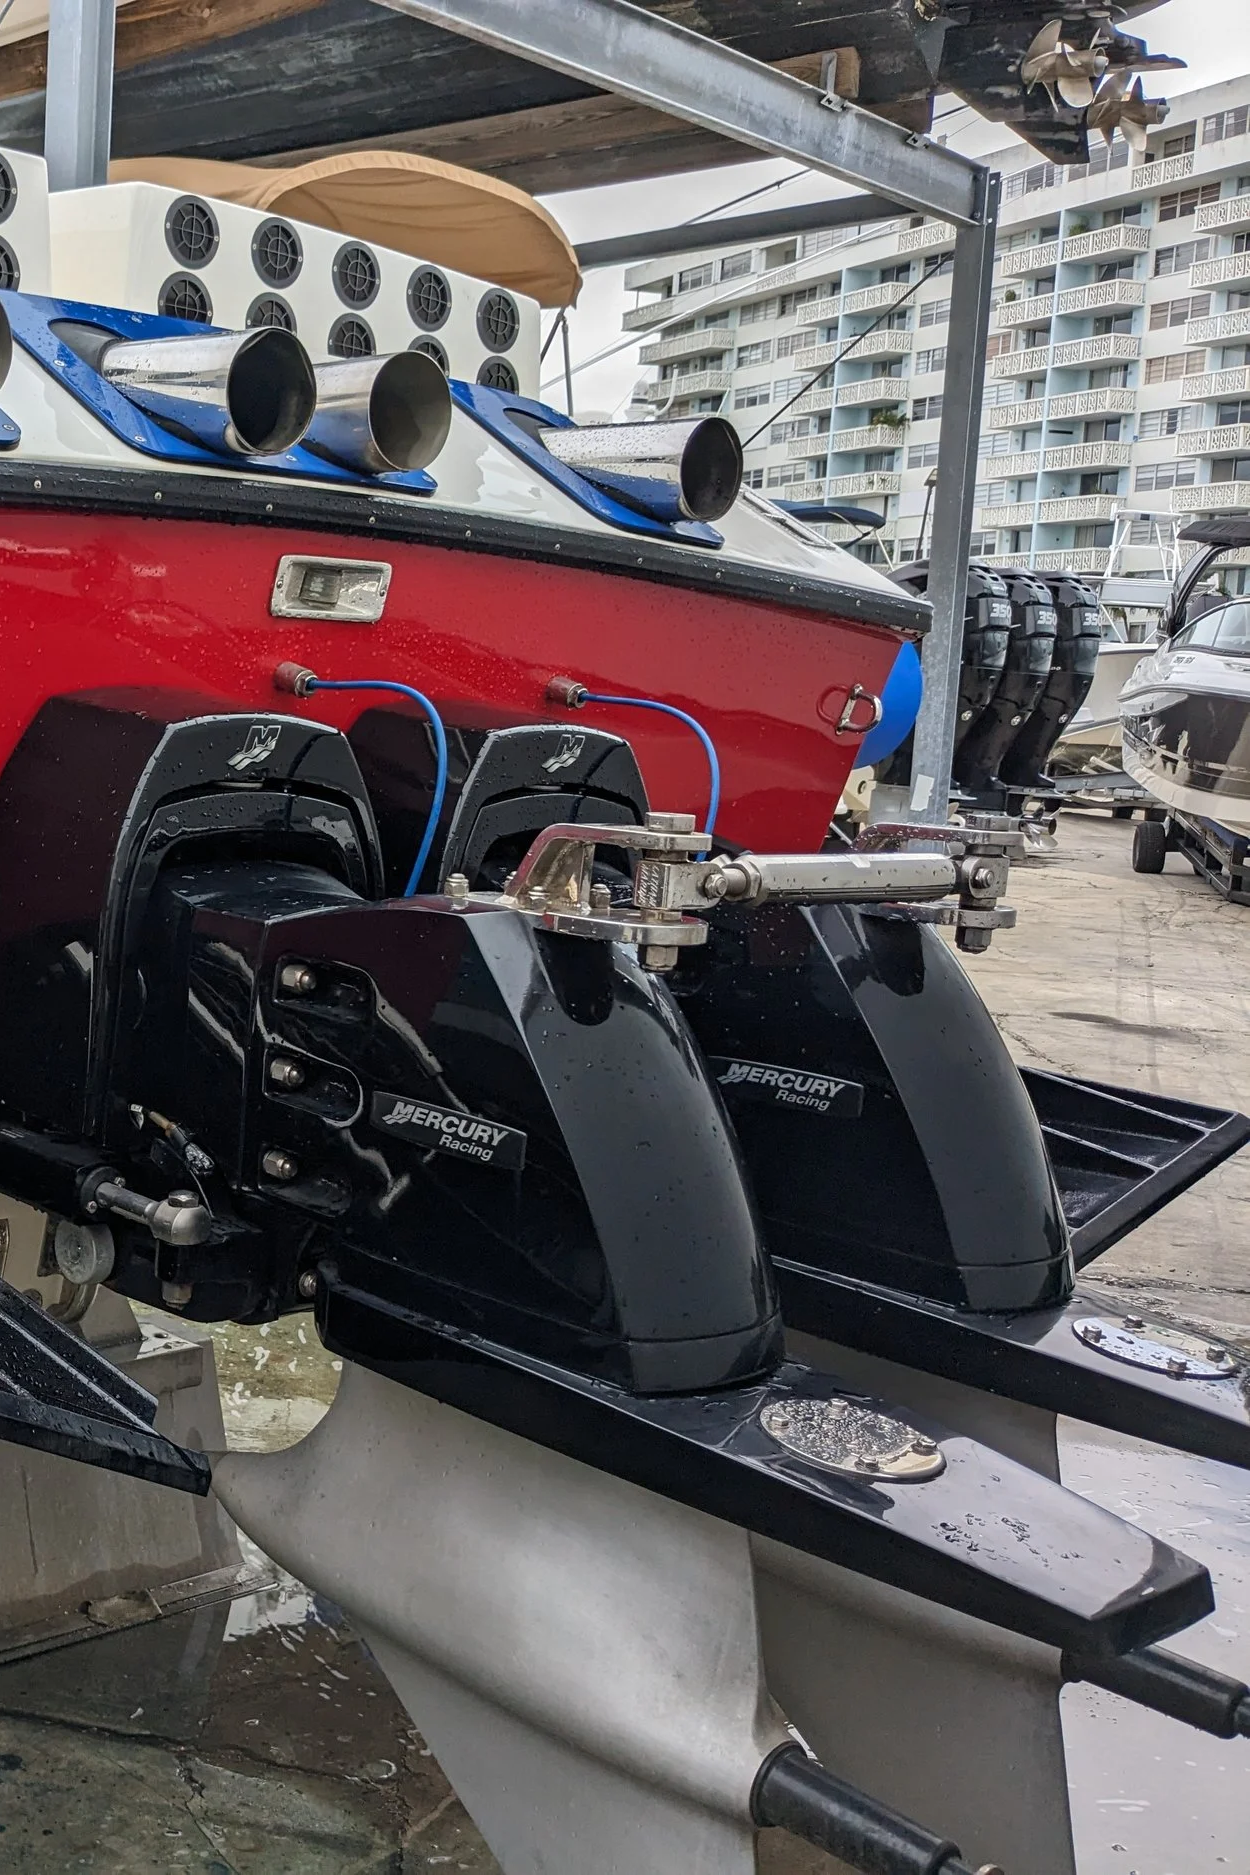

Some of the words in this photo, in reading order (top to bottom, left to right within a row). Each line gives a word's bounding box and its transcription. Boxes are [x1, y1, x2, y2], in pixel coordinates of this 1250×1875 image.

[990, 603, 1012, 619] 350
[1036, 611, 1058, 625] 350
[717, 1063, 845, 1099] MERCURY
[775, 1089, 830, 1111] Racing
[382, 1101, 509, 1147] MERCURY
[439, 1134, 493, 1162] Racing
